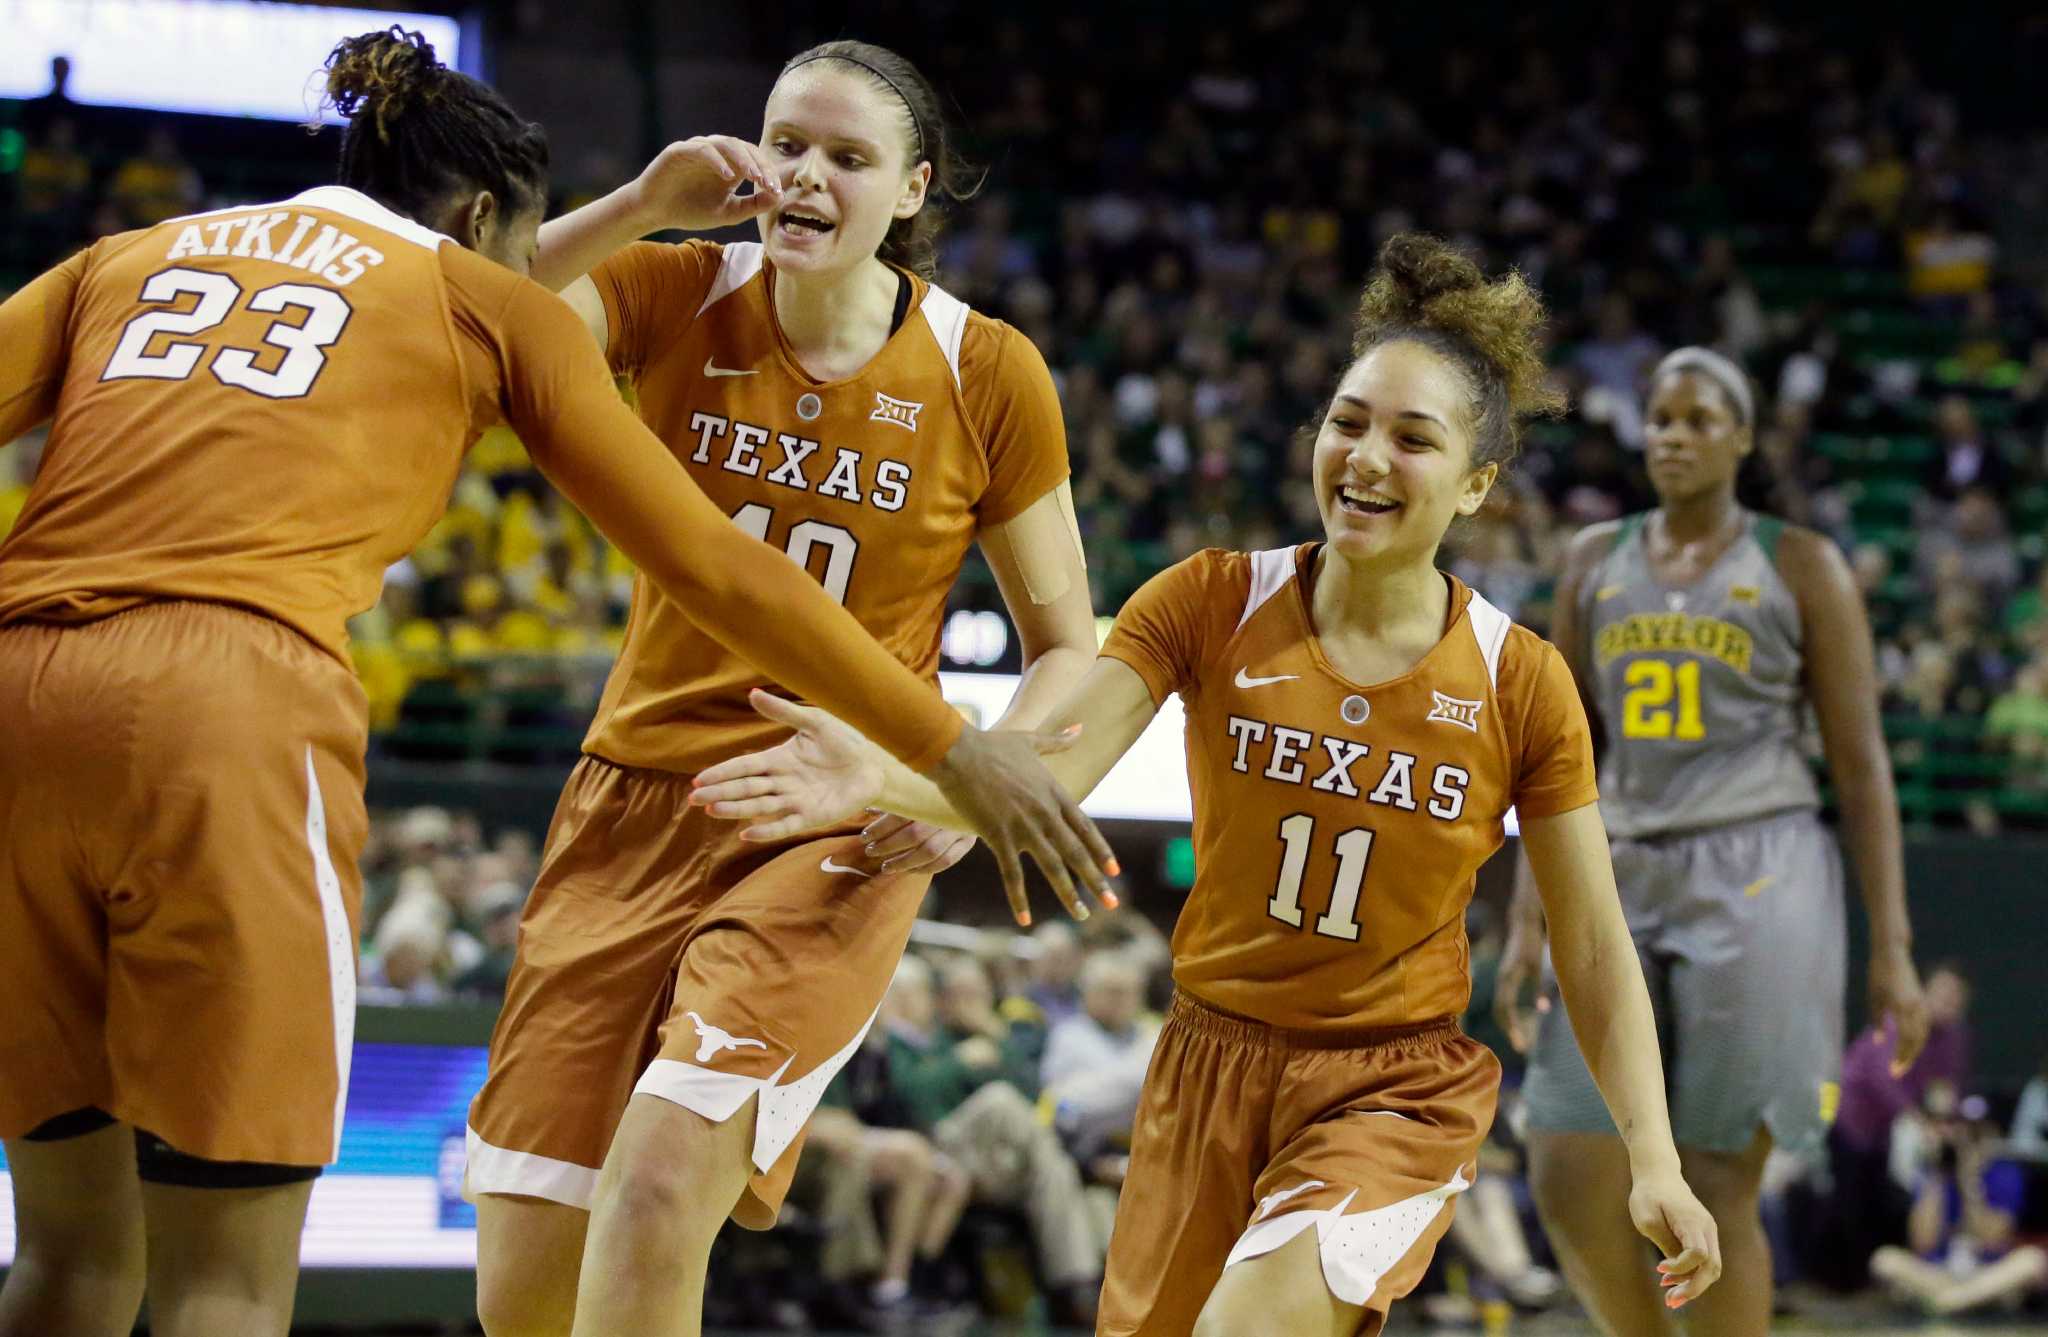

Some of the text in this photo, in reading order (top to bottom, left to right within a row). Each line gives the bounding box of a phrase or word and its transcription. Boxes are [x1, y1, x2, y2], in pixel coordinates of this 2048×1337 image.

[168, 212, 384, 285] ATKINS
[99, 267, 352, 398] 23
[690, 413, 911, 511] TEXAS
[1623, 659, 1705, 741] 21
[1228, 716, 1470, 820] TEXAS
[1268, 813, 1375, 940] 11
